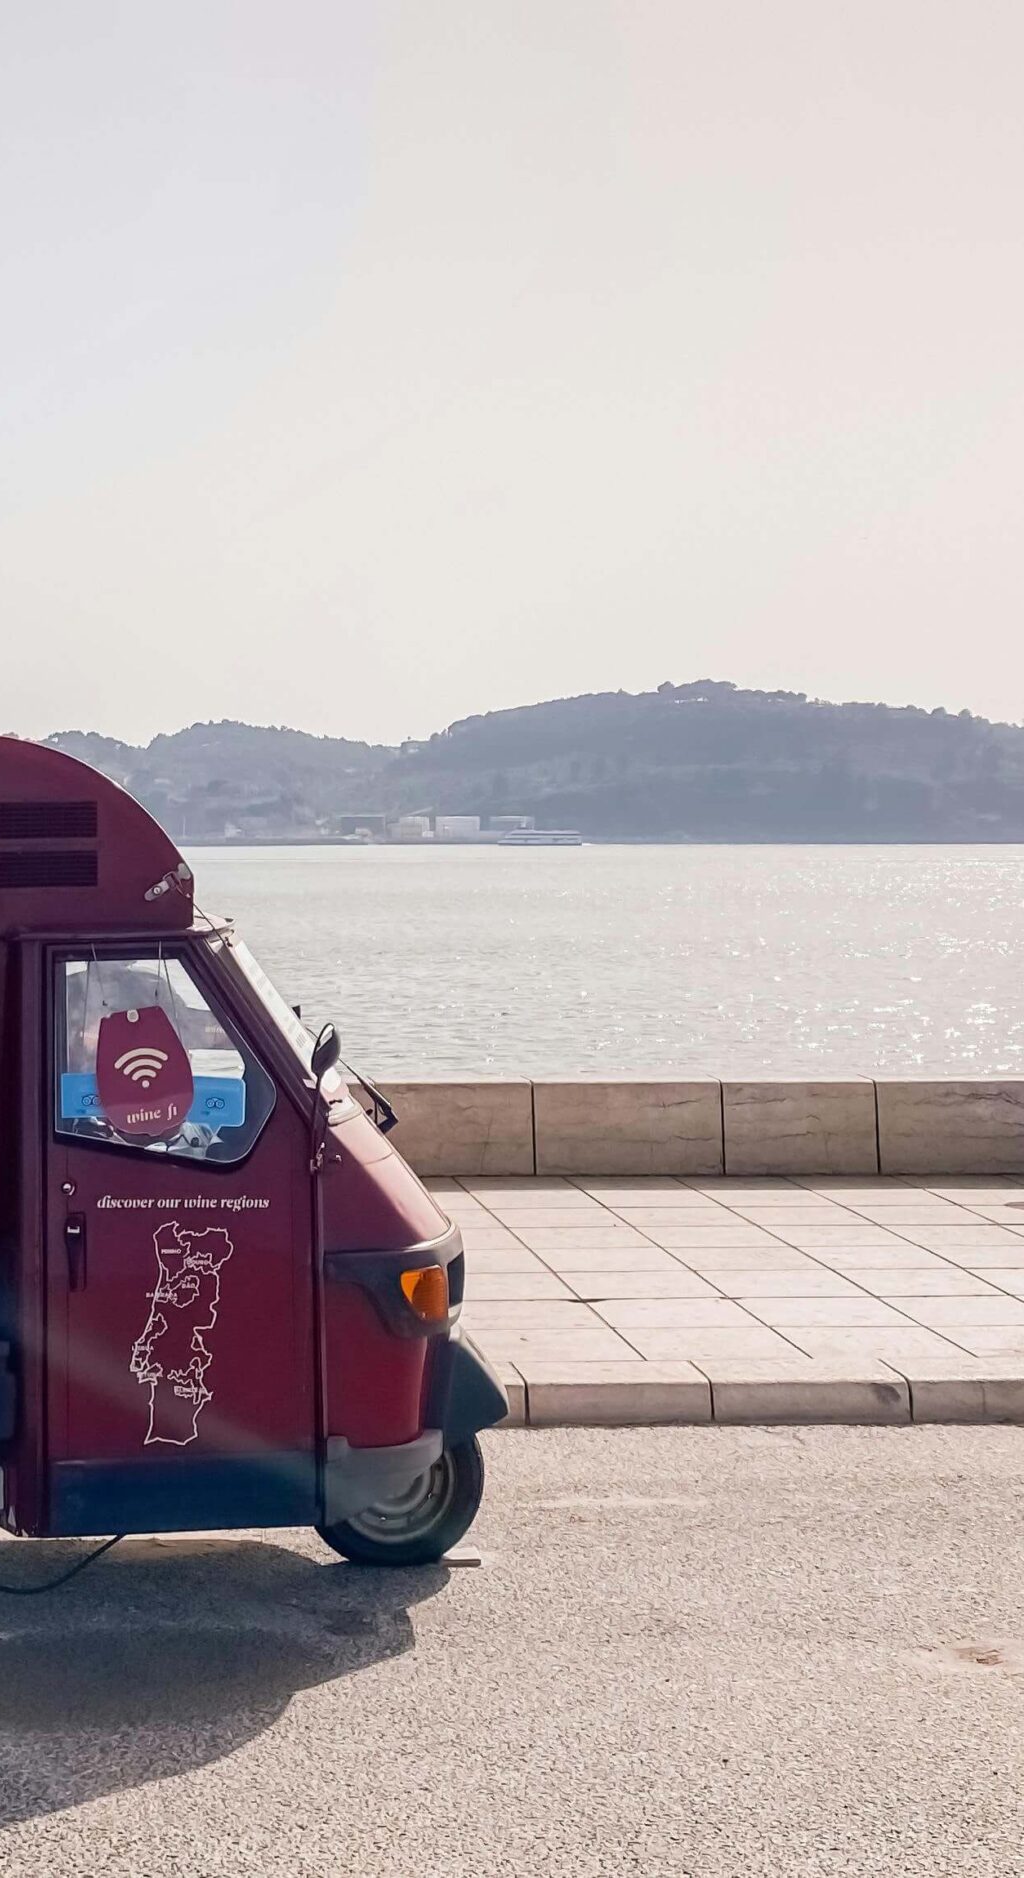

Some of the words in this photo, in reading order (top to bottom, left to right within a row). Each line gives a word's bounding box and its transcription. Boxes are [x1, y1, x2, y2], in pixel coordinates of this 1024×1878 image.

[127, 1108, 161, 1124] wine
[96, 1195, 155, 1209] discover
[157, 1198, 182, 1209] our
[184, 1195, 217, 1209] wine
[220, 1195, 270, 1212] regions
